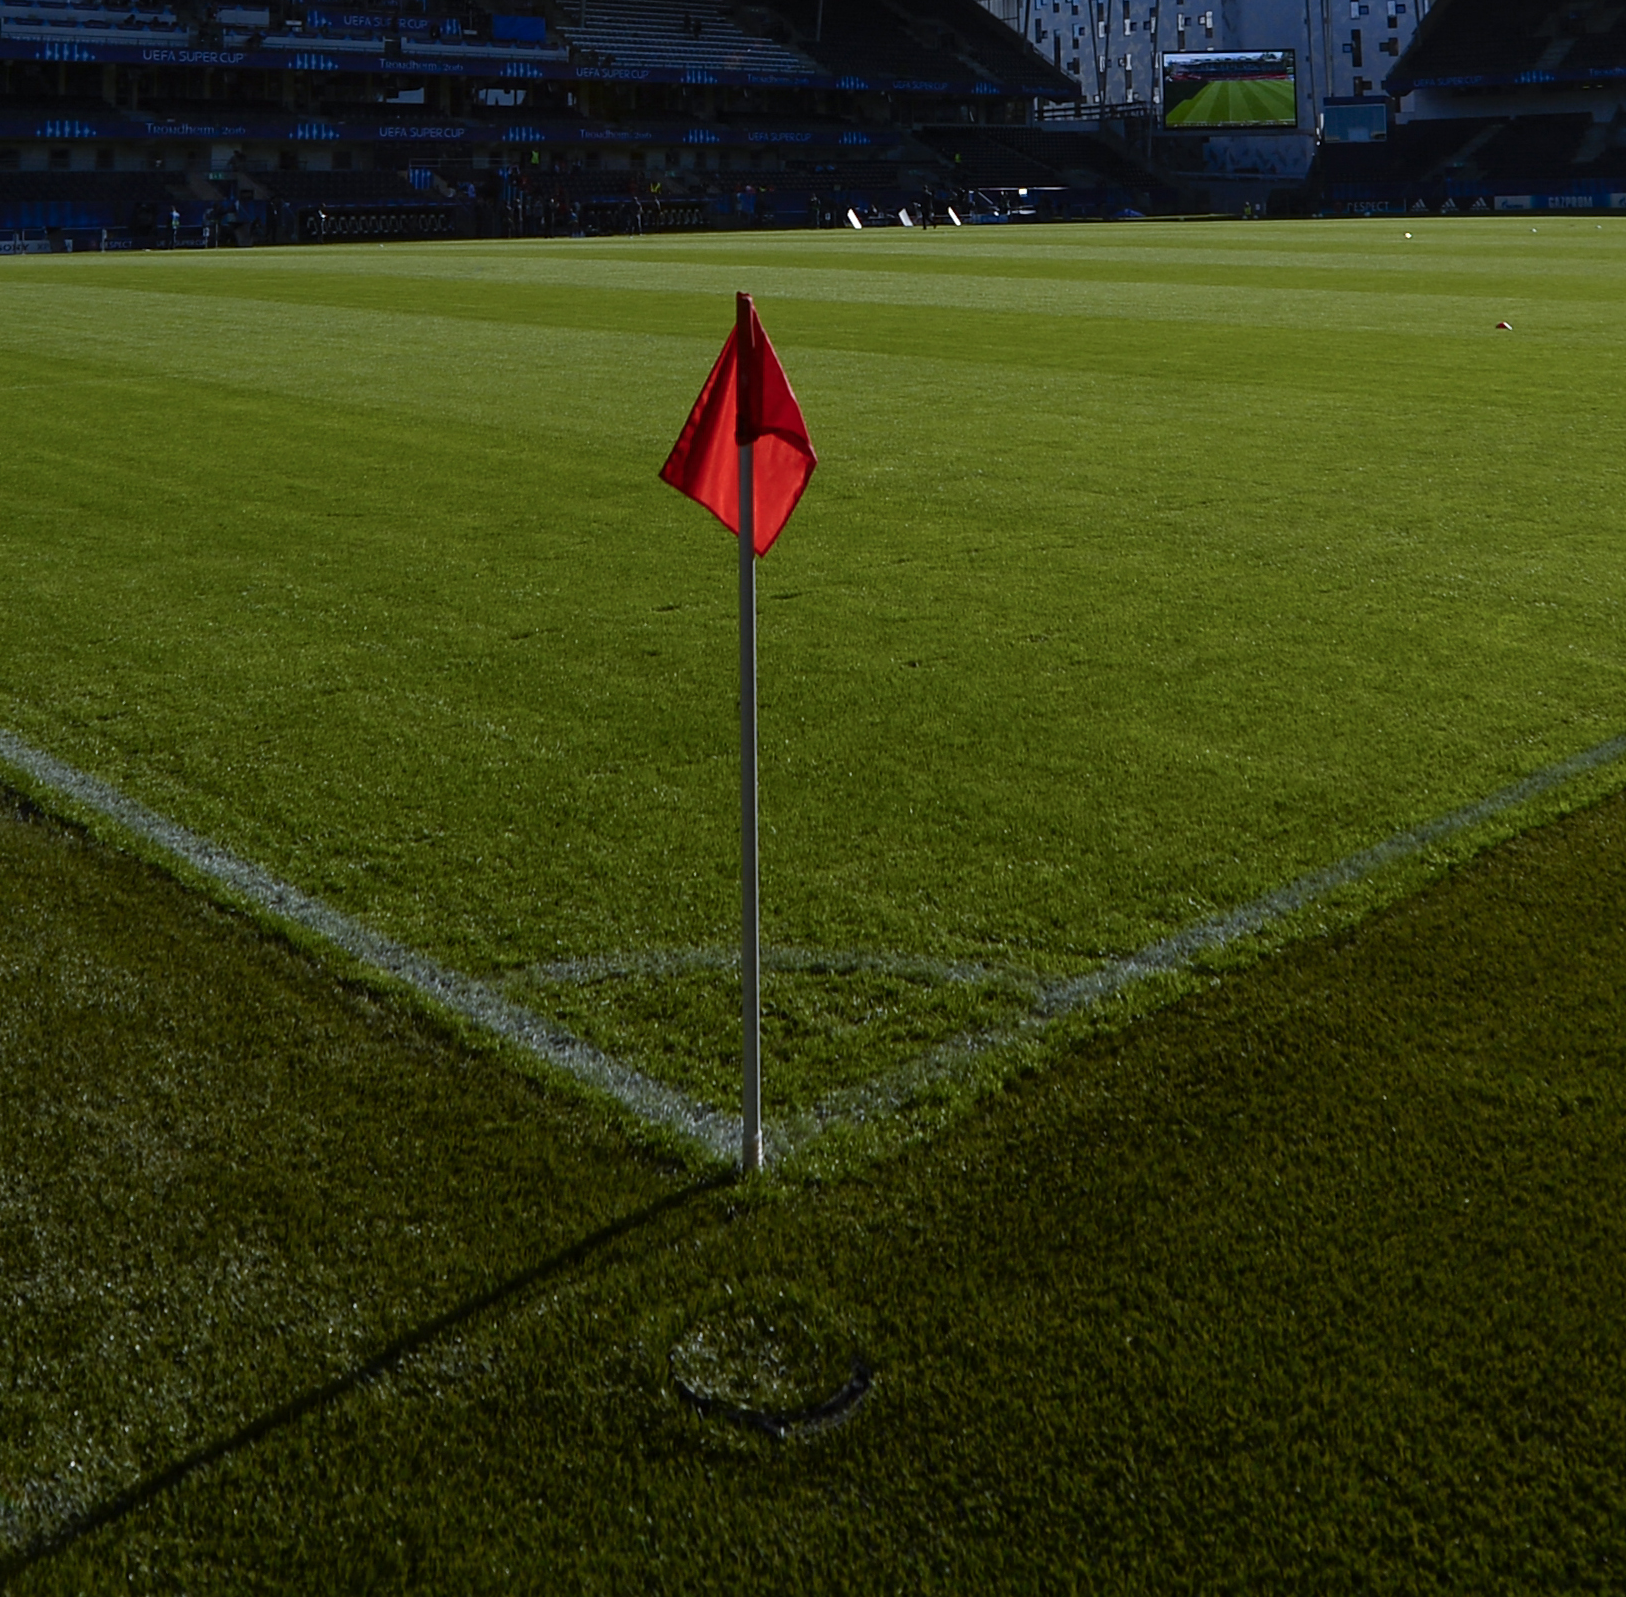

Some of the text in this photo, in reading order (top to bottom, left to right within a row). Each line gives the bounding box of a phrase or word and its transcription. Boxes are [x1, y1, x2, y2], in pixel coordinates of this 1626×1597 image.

[343, 15, 371, 27] UEFA
[409, 18, 428, 29] CUP
[142, 49, 244, 64] UEFA SUPER CUP
[576, 67, 649, 79] UEFA SUPER CUP
[379, 126, 465, 138] UEFA SUPER CUP
